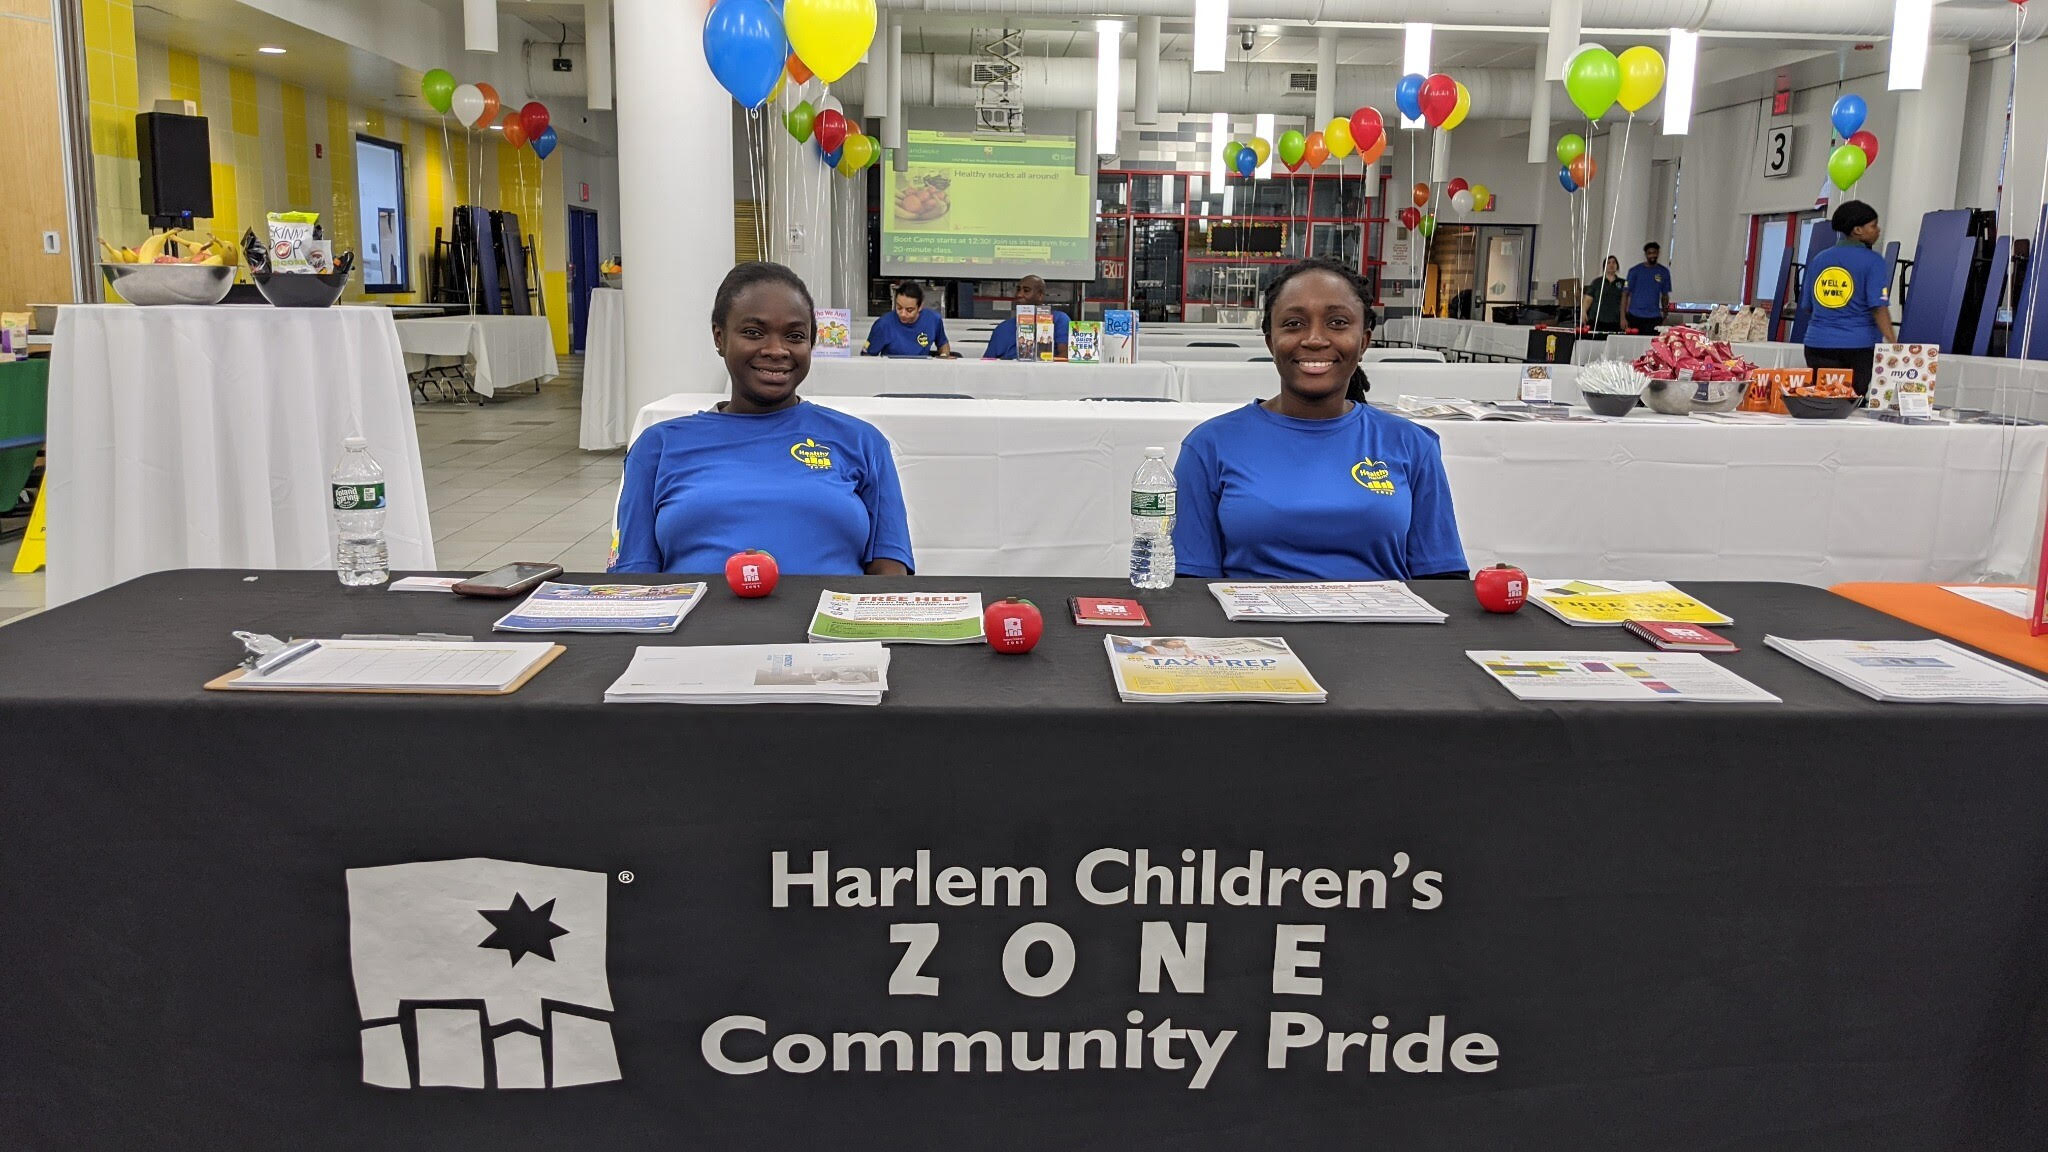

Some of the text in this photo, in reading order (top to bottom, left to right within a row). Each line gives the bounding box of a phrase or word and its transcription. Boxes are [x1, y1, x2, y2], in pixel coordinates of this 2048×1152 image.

[1771, 132, 1786, 171] 3
[954, 169, 1060, 181] Healthy snacks all around!
[893, 235, 912, 244] Boot
[913, 236, 935, 246] Camp
[937, 237, 957, 245] starts
[1028, 239, 1040, 247] the
[1103, 262, 1124, 278] EXIT
[1107, 318, 1130, 332] Red
[1757, 373, 1770, 387] W
[1789, 374, 1806, 388] W
[1891, 370, 1906, 379] my
[799, 449, 830, 457] Healthy
[336, 486, 358, 497] Poland
[1149, 658, 1199, 666] TAX
[1207, 658, 1277, 667] PREP
[772, 847, 1443, 910] Harlem Children's
[888, 921, 1326, 998] ZONE
[701, 1009, 1500, 1090] Community Pride
